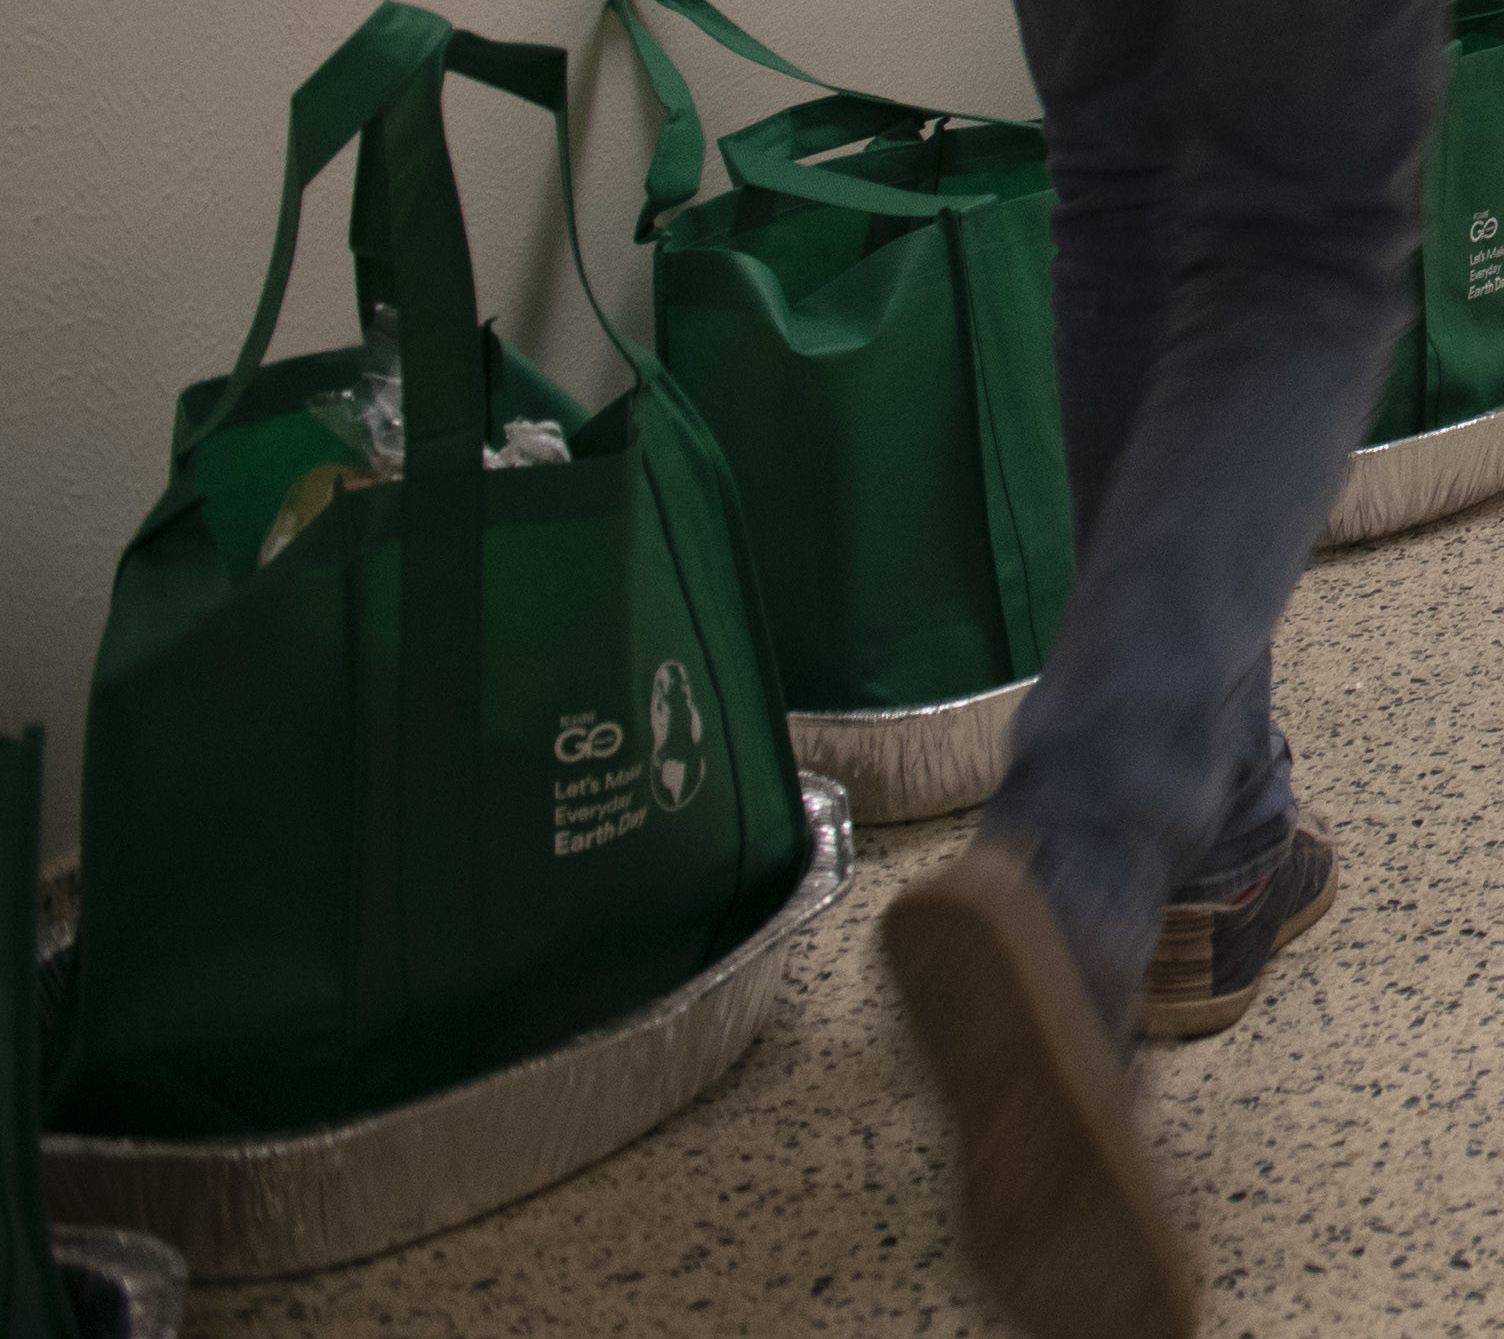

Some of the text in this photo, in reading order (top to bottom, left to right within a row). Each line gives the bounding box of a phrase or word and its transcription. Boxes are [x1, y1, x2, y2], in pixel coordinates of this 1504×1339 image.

[1469, 216, 1499, 243] GO
[1469, 250, 1486, 267] Let's
[1469, 263, 1502, 283] Everyday
[1467, 279, 1495, 301] Earth
[554, 775, 600, 802] Let's
[554, 793, 633, 826] Everyday
[554, 806, 648, 857] Earth Day
